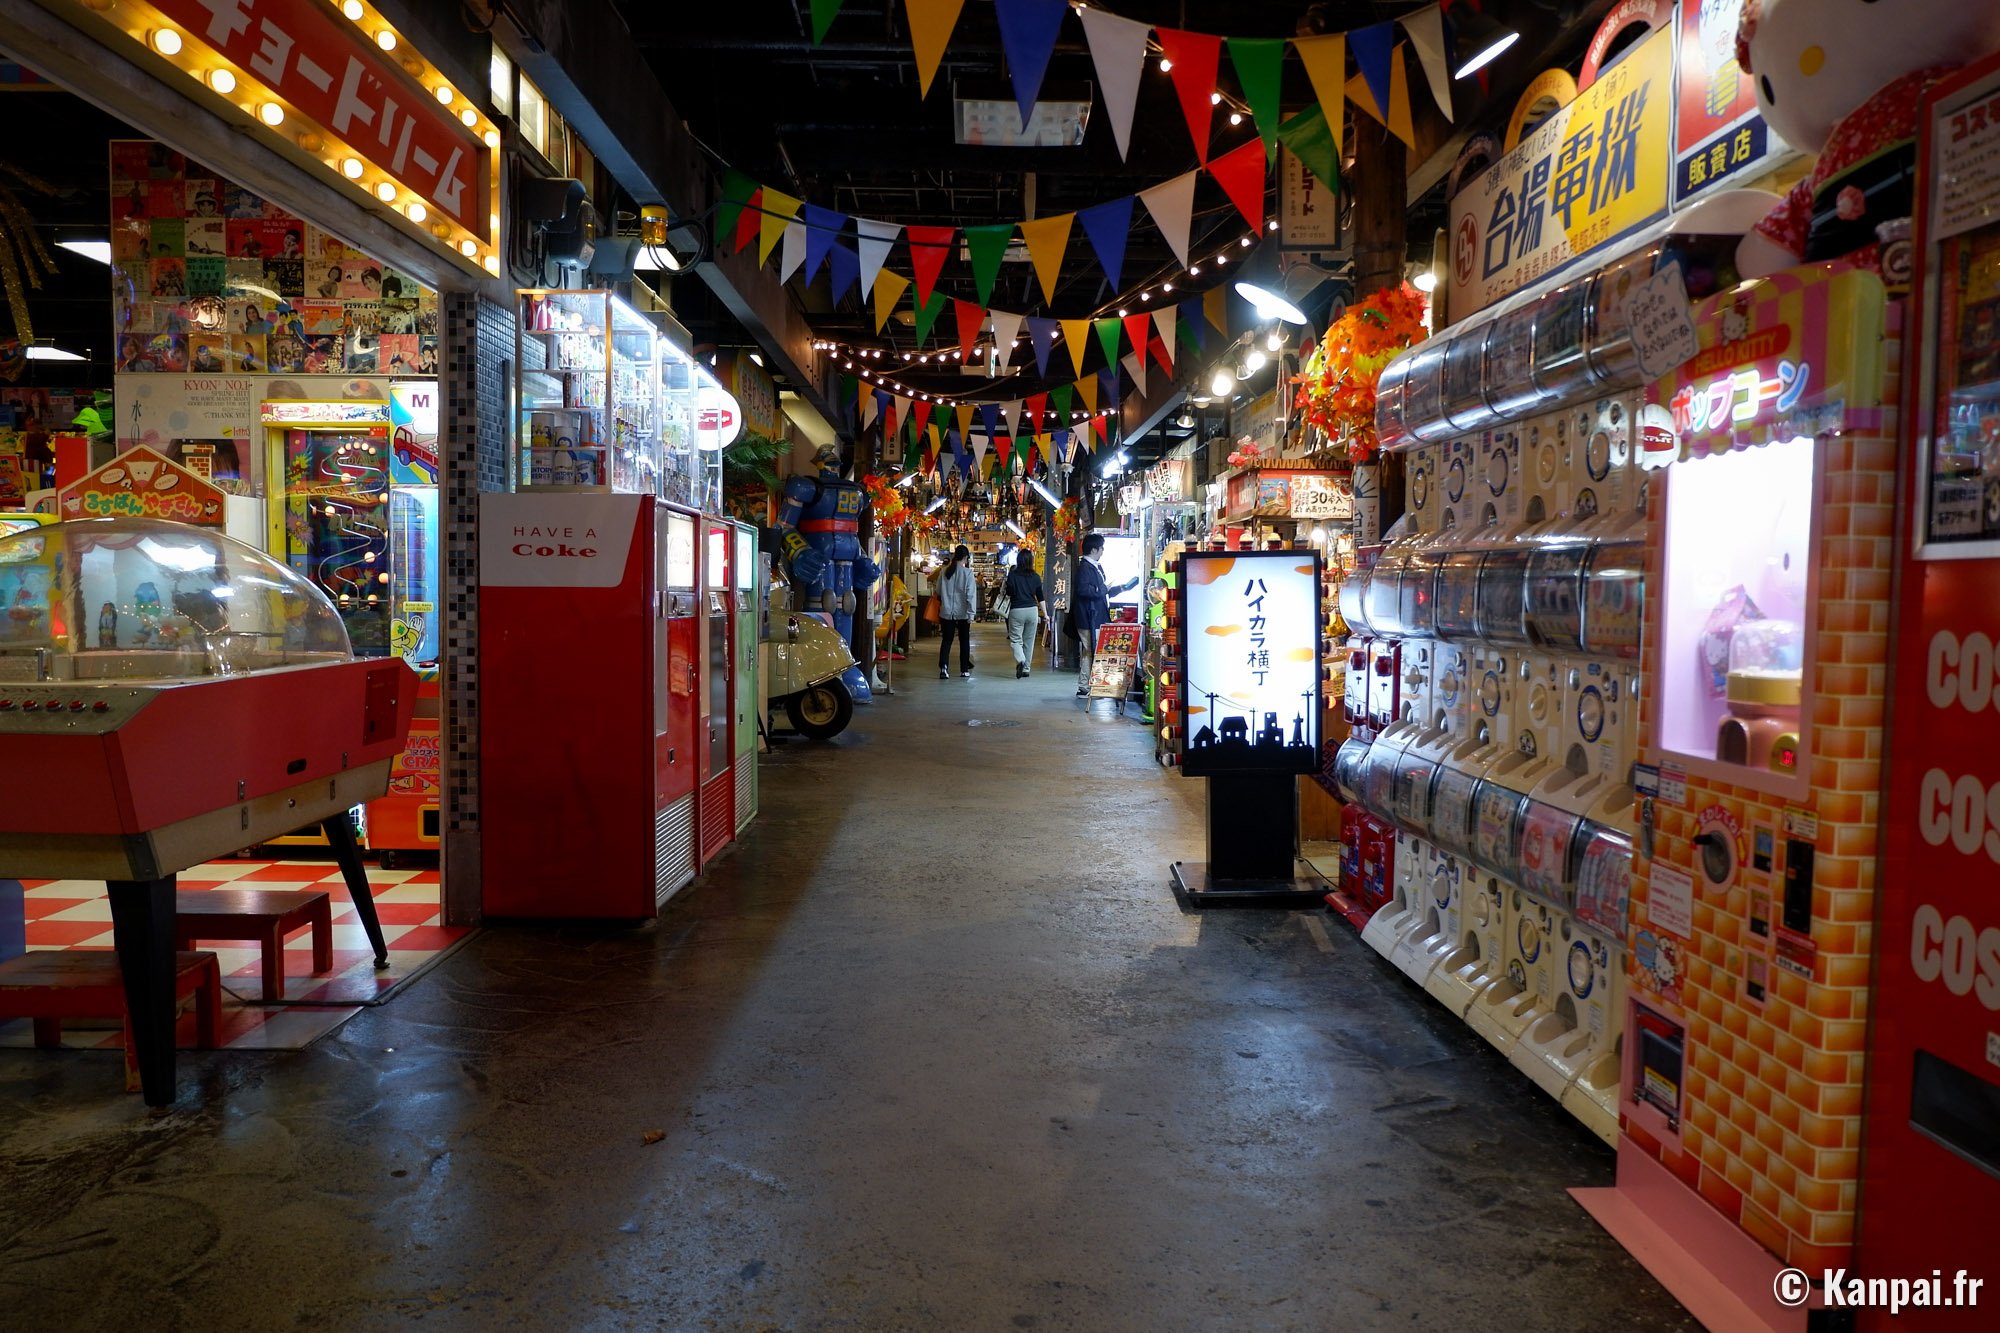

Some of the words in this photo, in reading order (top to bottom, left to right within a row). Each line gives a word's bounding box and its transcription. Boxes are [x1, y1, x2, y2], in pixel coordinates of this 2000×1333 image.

[1482, 79, 1651, 281] 台場電機
[1687, 128, 1752, 190] 販賣店
[1737, 330, 1777, 363] KITTY
[1670, 360, 1810, 436] ポップコーン
[513, 527, 573, 538] HAVE
[586, 528, 597, 538] A
[837, 491, 859, 514] 28
[512, 543, 597, 558] Coke
[1244, 578, 1270, 686] ハイカラ横丁
[1927, 630, 2000, 713] CO
